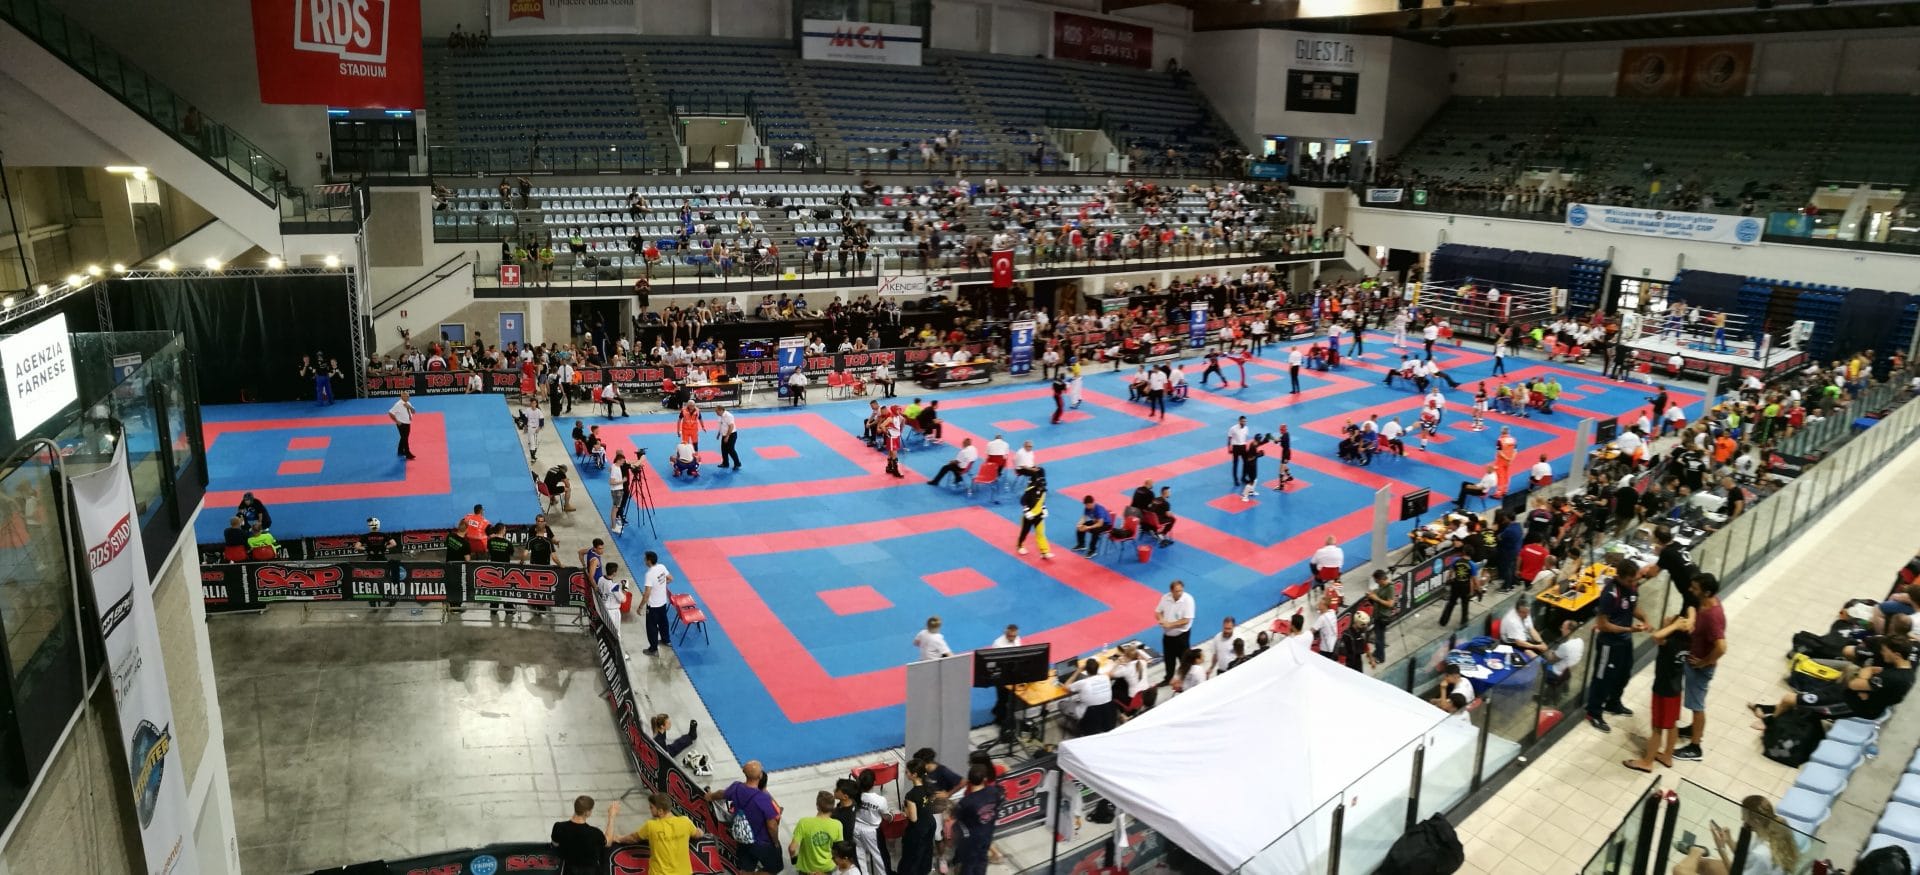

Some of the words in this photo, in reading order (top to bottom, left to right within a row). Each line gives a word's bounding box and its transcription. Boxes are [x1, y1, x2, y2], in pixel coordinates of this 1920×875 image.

[511, 3, 540, 12] CARLO
[311, 0, 371, 48] RDS
[829, 26, 884, 49] MCA
[1296, 40, 1354, 63] GUEST.it
[340, 63, 387, 78] STADIUM
[1018, 331, 1027, 344] 5
[16, 341, 63, 379] AGENZIA
[787, 348, 797, 364] 7
[807, 356, 835, 370] TEN
[843, 353, 869, 367] TOP
[869, 350, 896, 365] TEN
[608, 369, 635, 382] TOP
[636, 368, 664, 382] TEN
[736, 361, 761, 376] TOP
[762, 360, 779, 374] TE
[17, 358, 66, 399] FARNESE
[425, 374, 454, 388] TOP
[492, 373, 517, 386] TOP
[89, 543, 110, 570] RDS
[110, 519, 130, 552] STAD
[315, 548, 359, 556] FIGHTING
[402, 543, 445, 551] FIGHTING
[256, 566, 343, 590] SAP
[475, 566, 558, 593] SAP
[202, 585, 229, 599] ALIA
[257, 589, 308, 598] FIGHTING
[312, 587, 343, 596] STYLE
[352, 581, 380, 595] LEGA
[410, 582, 447, 595] ITALIA
[475, 588, 522, 599] FIGHTING
[527, 592, 556, 601] STYLE
[598, 638, 609, 667] LEGA
[603, 655, 618, 682] PRO
[610, 675, 625, 709] ITALIA
[998, 797, 1041, 818] STYLE
